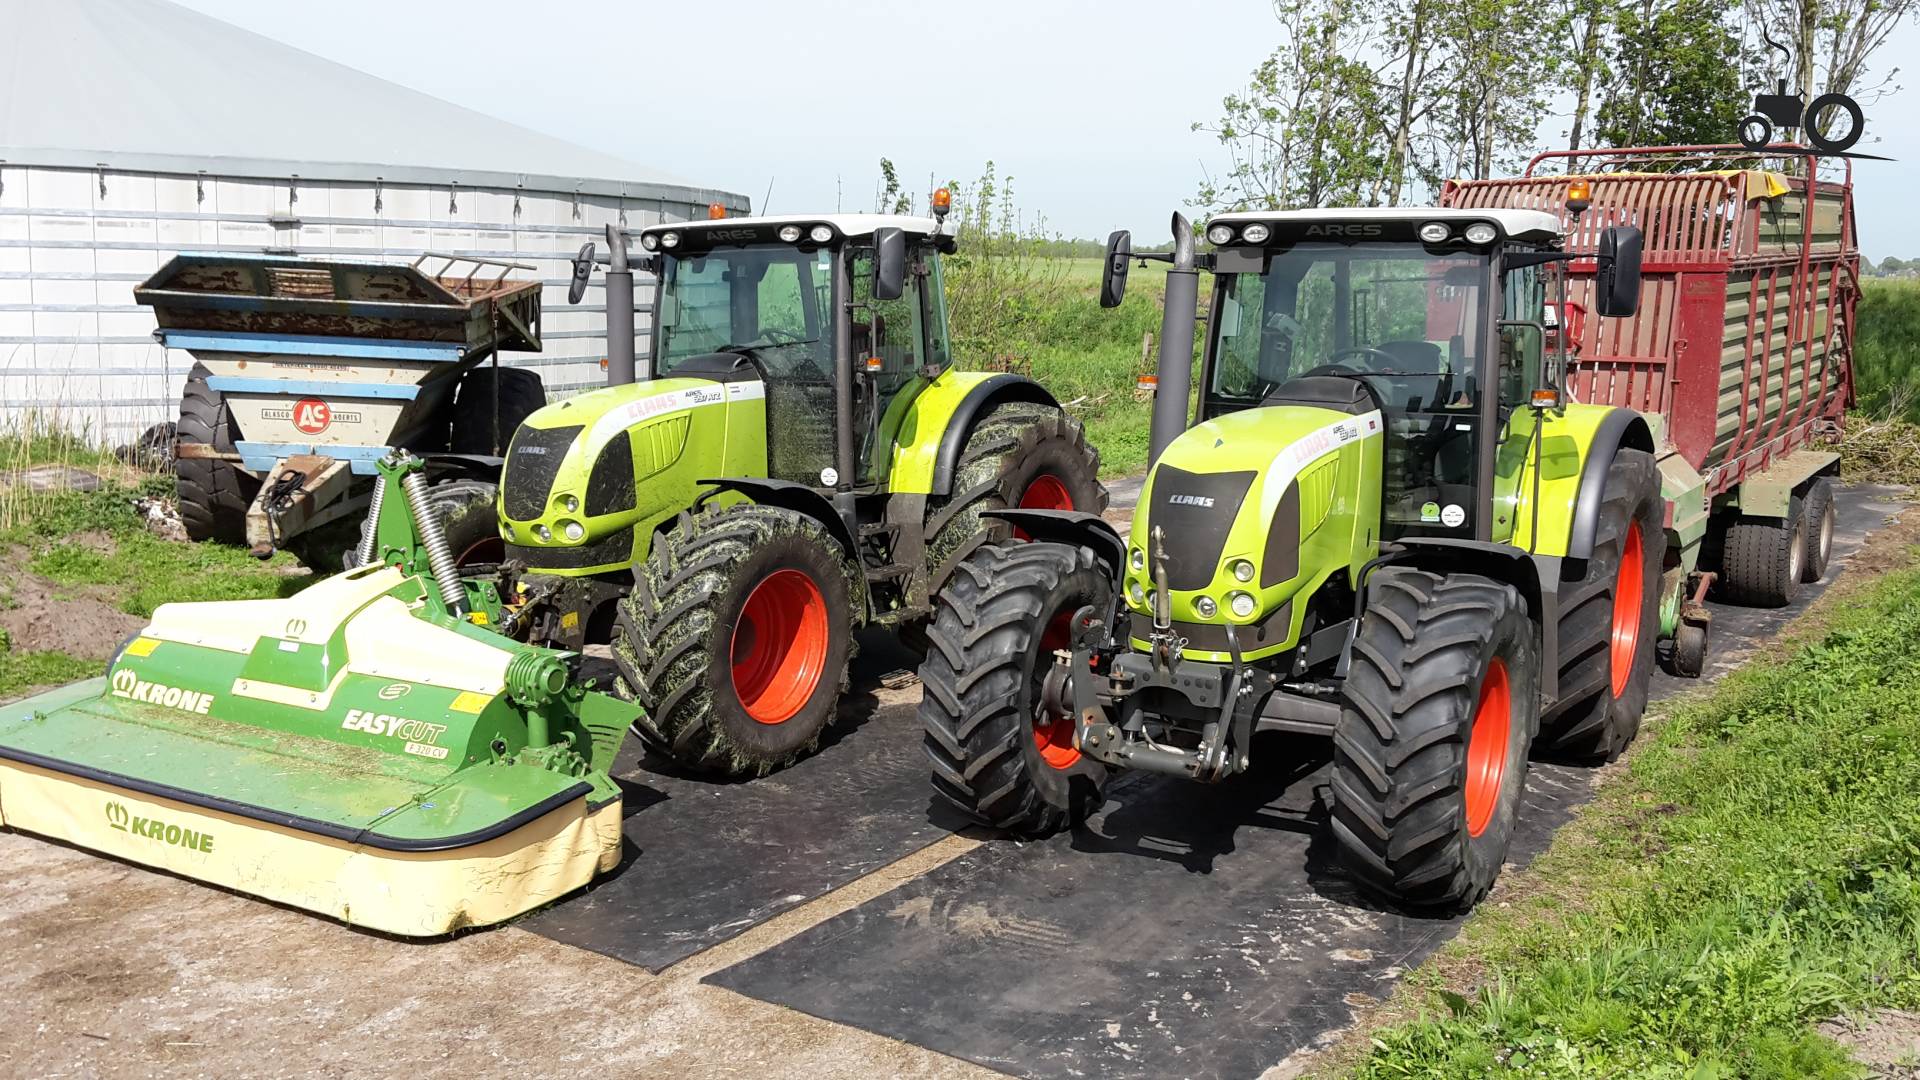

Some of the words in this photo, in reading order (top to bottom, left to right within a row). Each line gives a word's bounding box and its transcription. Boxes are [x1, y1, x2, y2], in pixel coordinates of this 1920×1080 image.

[706, 229, 757, 241] ARES
[1305, 224, 1382, 236] ARES
[1169, 494, 1215, 508] CLAAS
[131, 681, 215, 715] KRONE
[131, 816, 214, 854] KRONE
